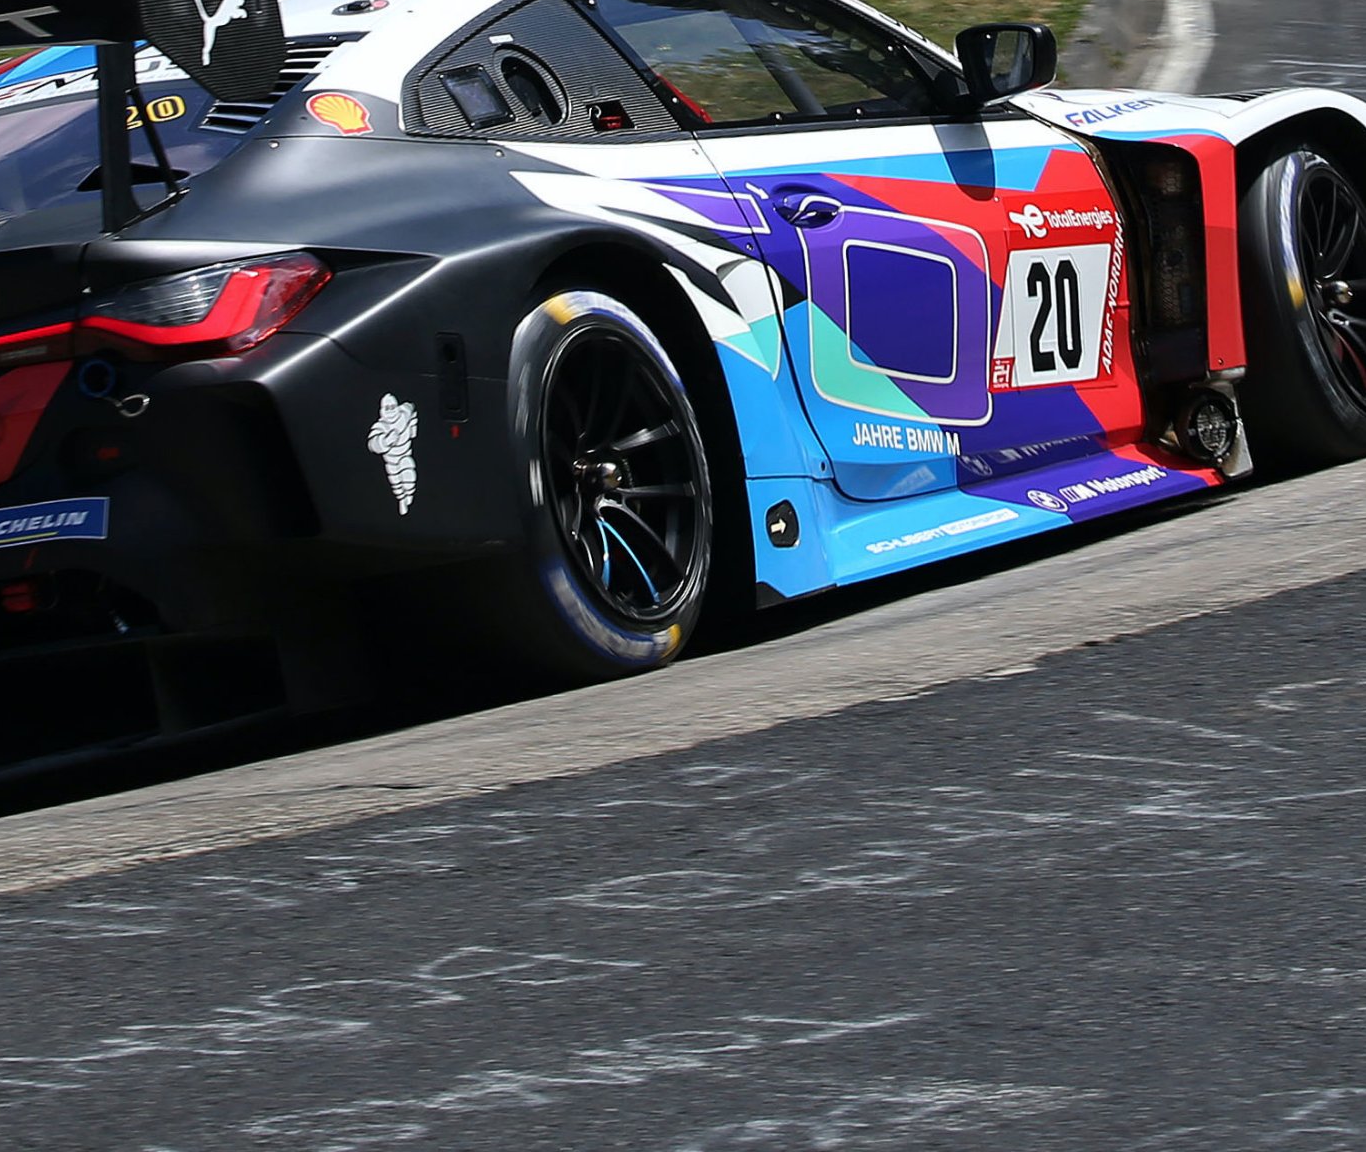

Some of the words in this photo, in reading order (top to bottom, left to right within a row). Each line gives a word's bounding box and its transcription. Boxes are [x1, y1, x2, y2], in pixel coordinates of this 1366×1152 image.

[125, 95, 187, 130] 20
[1065, 97, 1164, 128] FALKEN
[1044, 206, 1114, 231] TotalEnergies
[1026, 259, 1083, 373] 20
[852, 422, 905, 450] JAHRE
[907, 428, 944, 454] BMW
[946, 431, 961, 456] M
[1095, 464, 1169, 498] Motorsport
